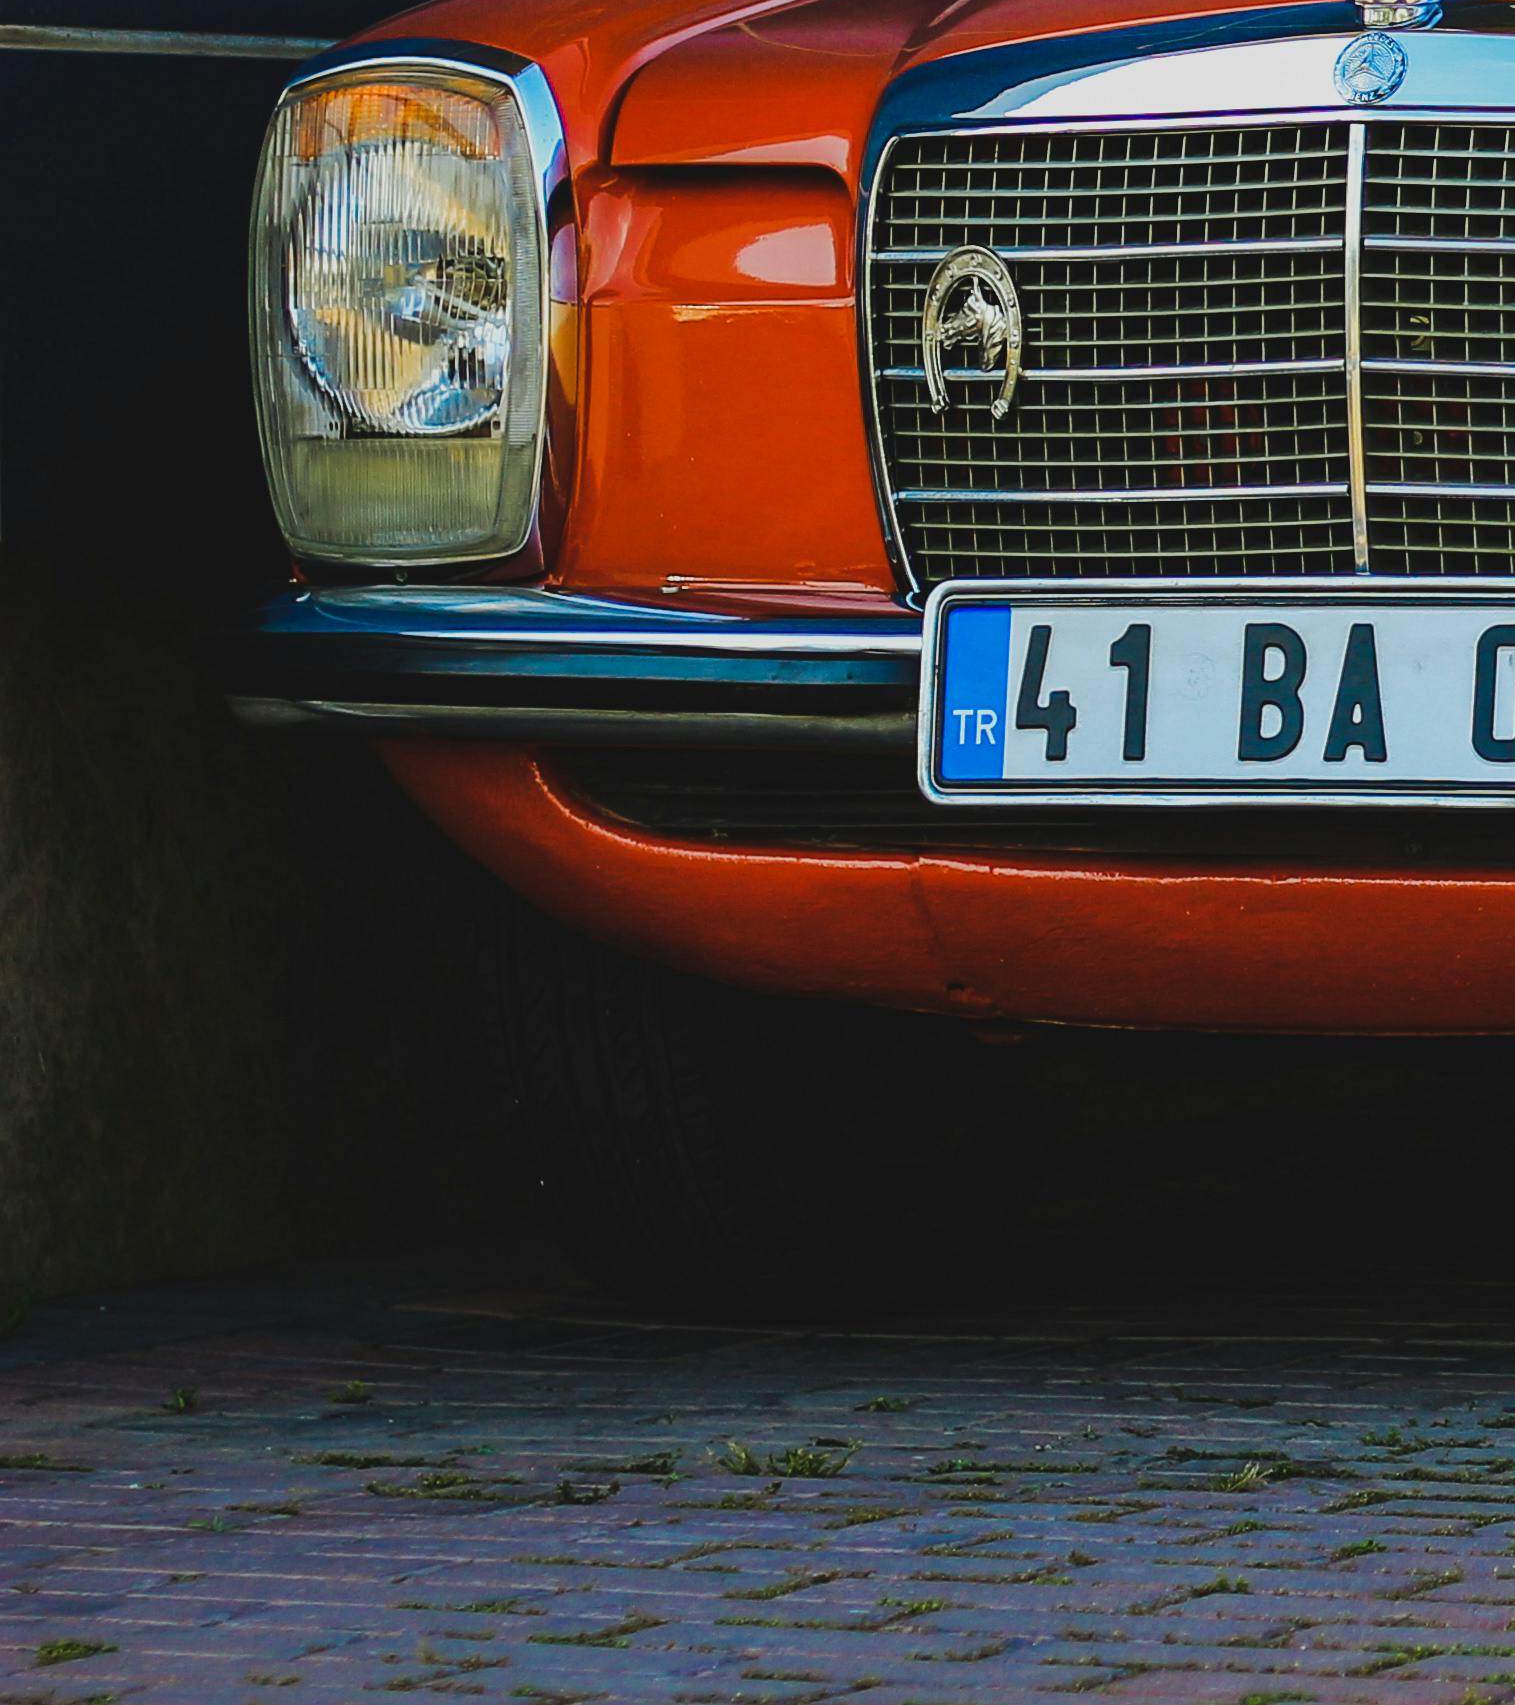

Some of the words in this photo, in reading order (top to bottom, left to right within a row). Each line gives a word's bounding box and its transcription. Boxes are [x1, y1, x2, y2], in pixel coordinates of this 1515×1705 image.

[953, 708, 997, 747] TR
[1014, 623, 1154, 763] 41
[1237, 622, 1388, 764] BA
